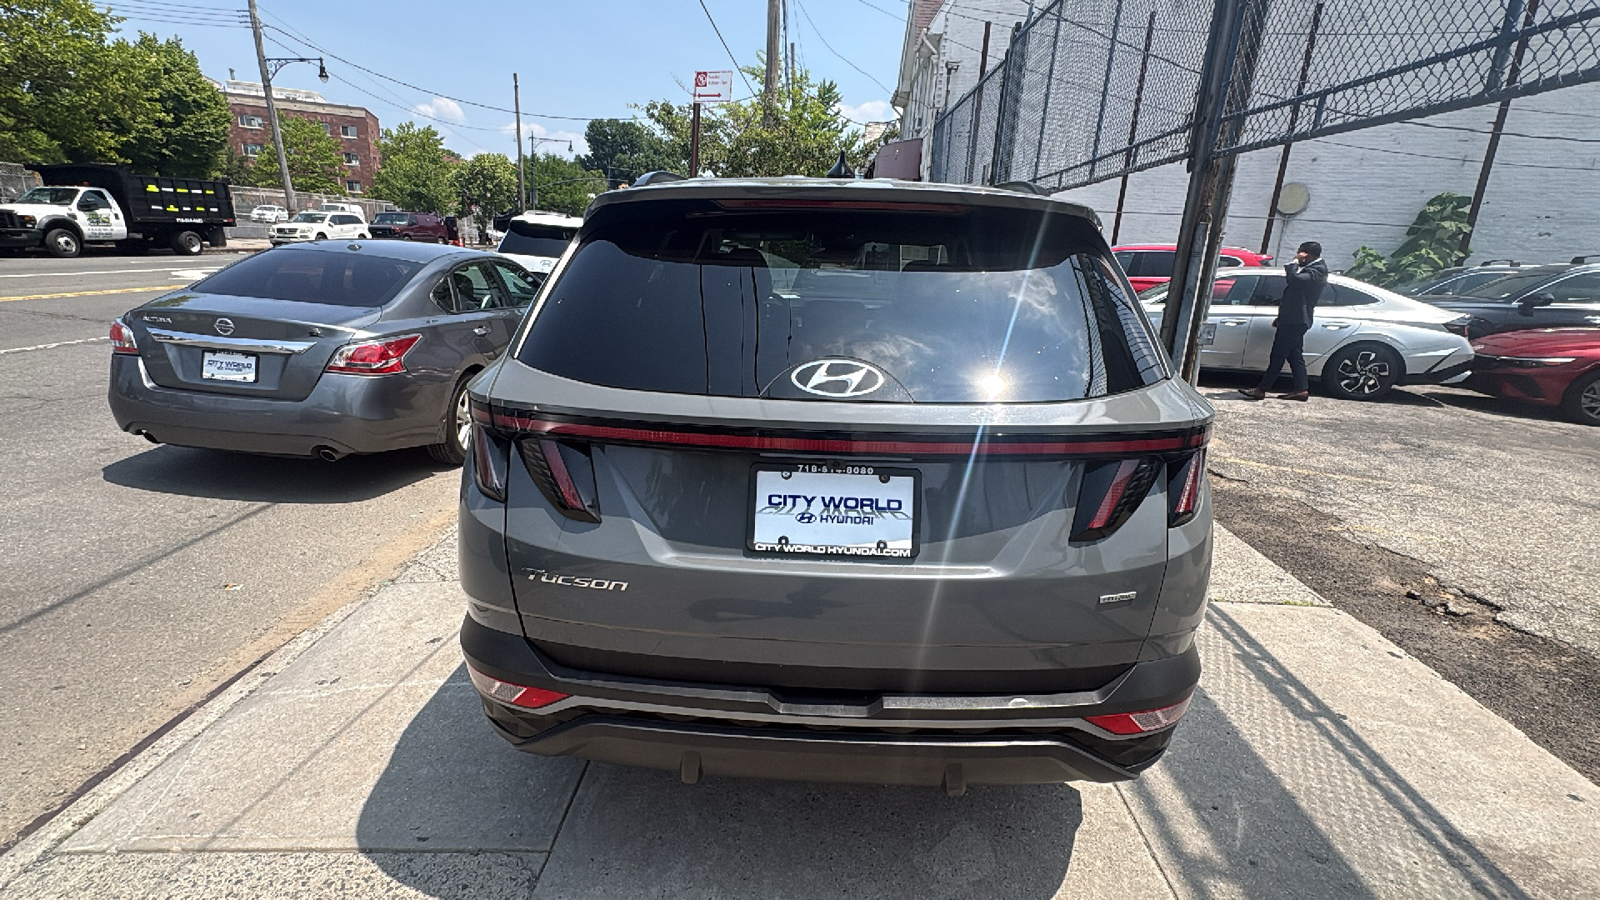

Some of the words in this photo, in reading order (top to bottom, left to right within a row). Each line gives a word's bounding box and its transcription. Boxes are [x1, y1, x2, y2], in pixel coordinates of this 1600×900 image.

[225, 361, 252, 369] WORLD
[767, 494, 817, 508] CITY
[821, 496, 902, 511] WORLD
[819, 514, 874, 525] HYUNDAI
[755, 542, 782, 552] CITY
[782, 544, 827, 554] WORLD
